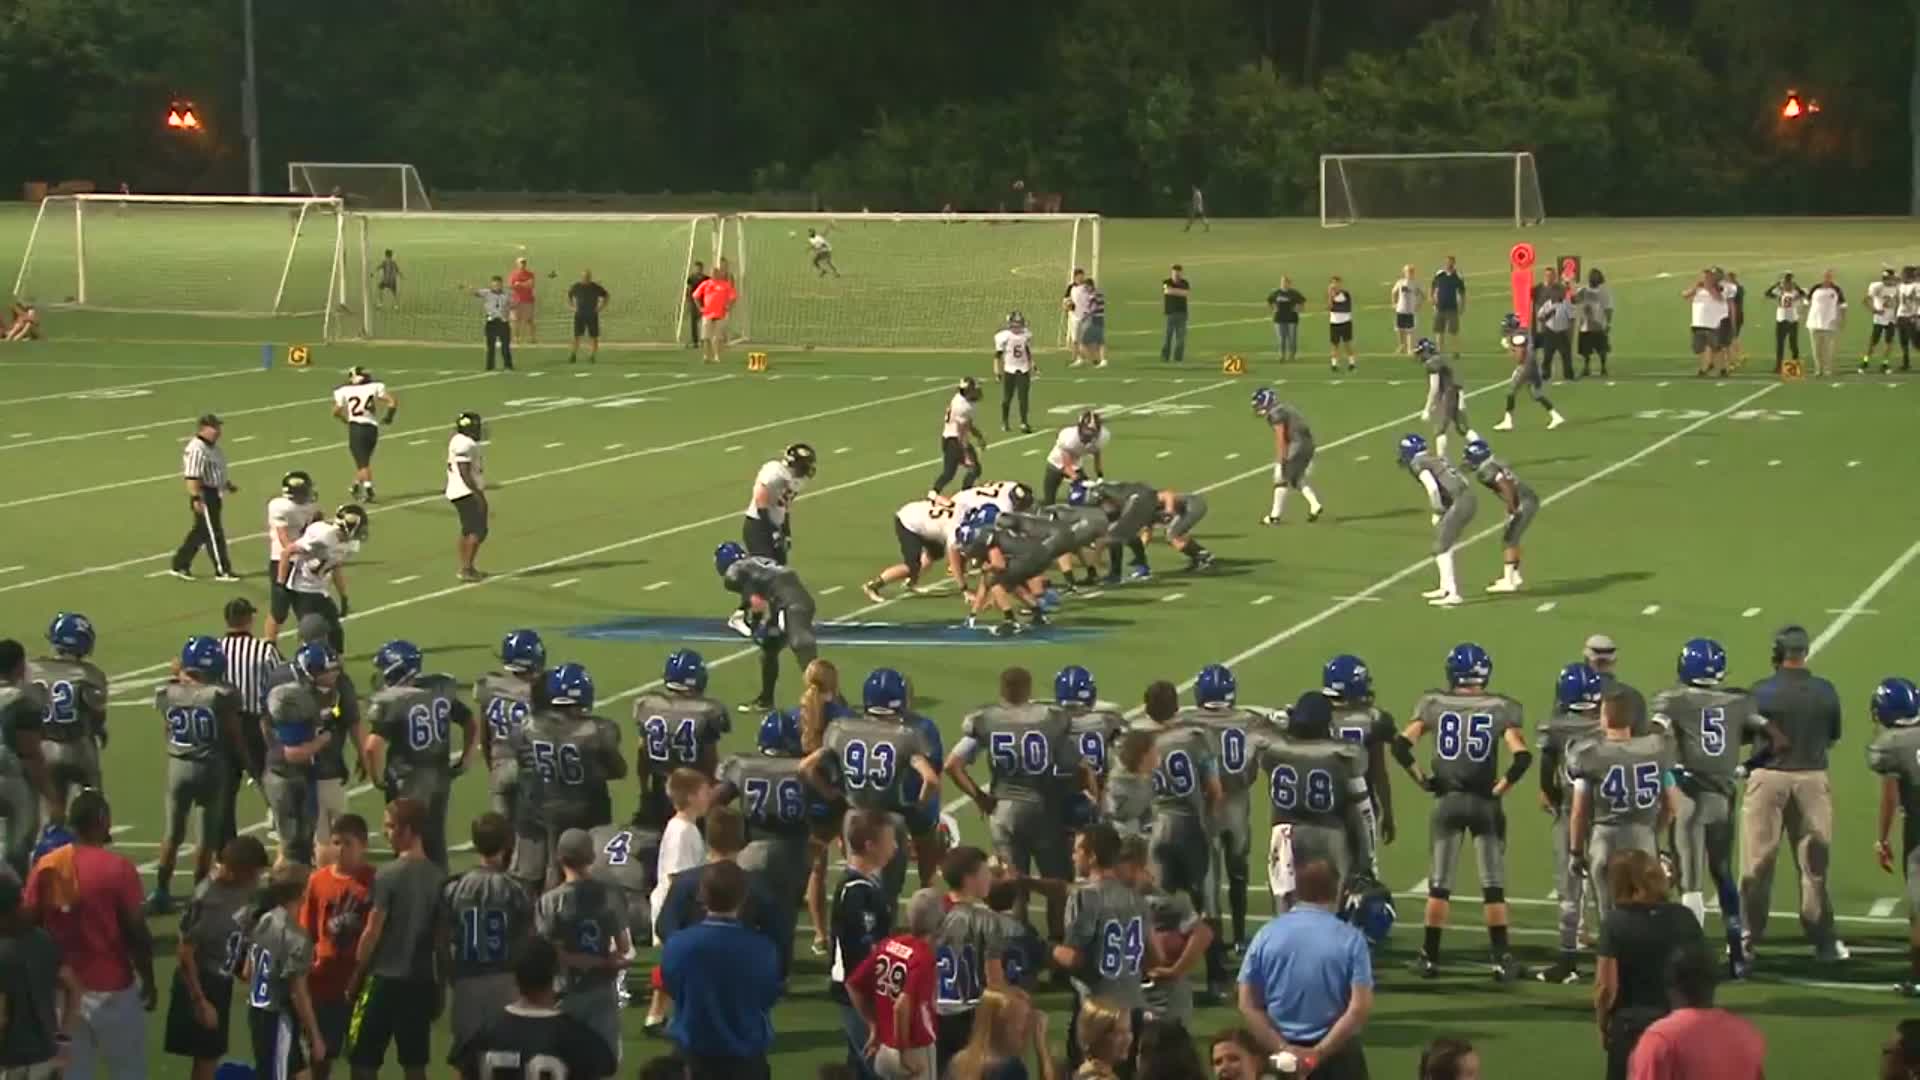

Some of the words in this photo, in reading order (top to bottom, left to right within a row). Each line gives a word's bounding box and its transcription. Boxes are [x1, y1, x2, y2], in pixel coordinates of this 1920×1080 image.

[290, 348, 305, 363] G
[348, 395, 377, 417] 24
[167, 705, 217, 747] 20
[644, 714, 696, 762] 24
[1437, 711, 1493, 760] 85
[1700, 707, 1726, 757] 5
[532, 739, 585, 785] 56
[844, 740, 897, 791] 93
[991, 730, 1049, 776] 50
[1271, 763, 1335, 812] 68
[1600, 761, 1661, 812] 45
[603, 831, 633, 865] 4
[463, 907, 508, 962] 19
[1099, 915, 1145, 978] 64
[875, 953, 908, 999] 29
